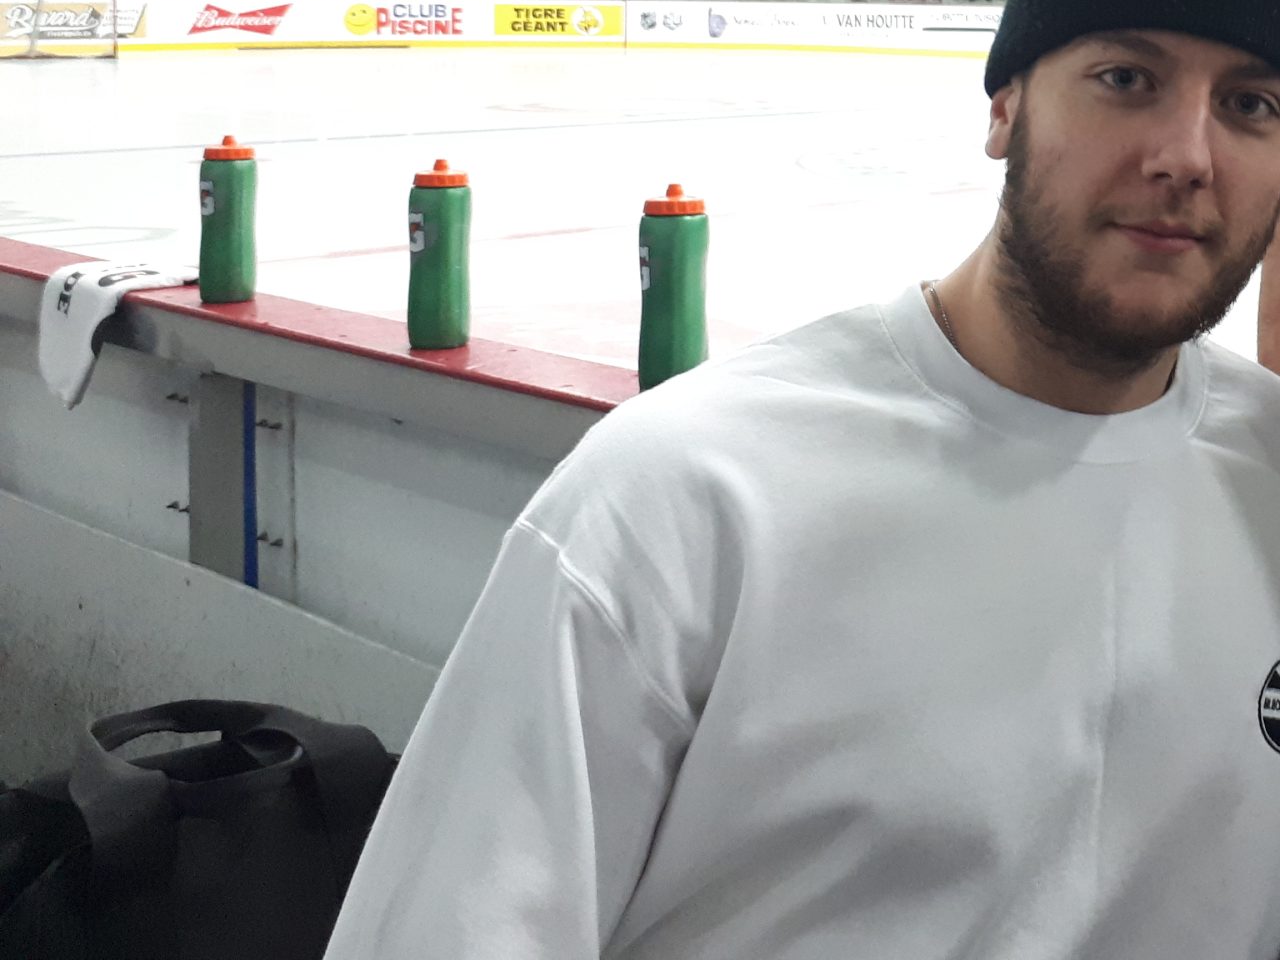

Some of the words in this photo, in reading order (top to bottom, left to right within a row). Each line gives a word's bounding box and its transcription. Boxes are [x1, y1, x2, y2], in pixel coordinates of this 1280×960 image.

[196, 8, 283, 28] Budweiser
[393, 4, 448, 18] CLUB
[514, 7, 565, 19] TIGRE
[376, 7, 464, 35] PISCINE
[837, 14, 862, 27] VAN
[866, 14, 914, 29] HOUTTE
